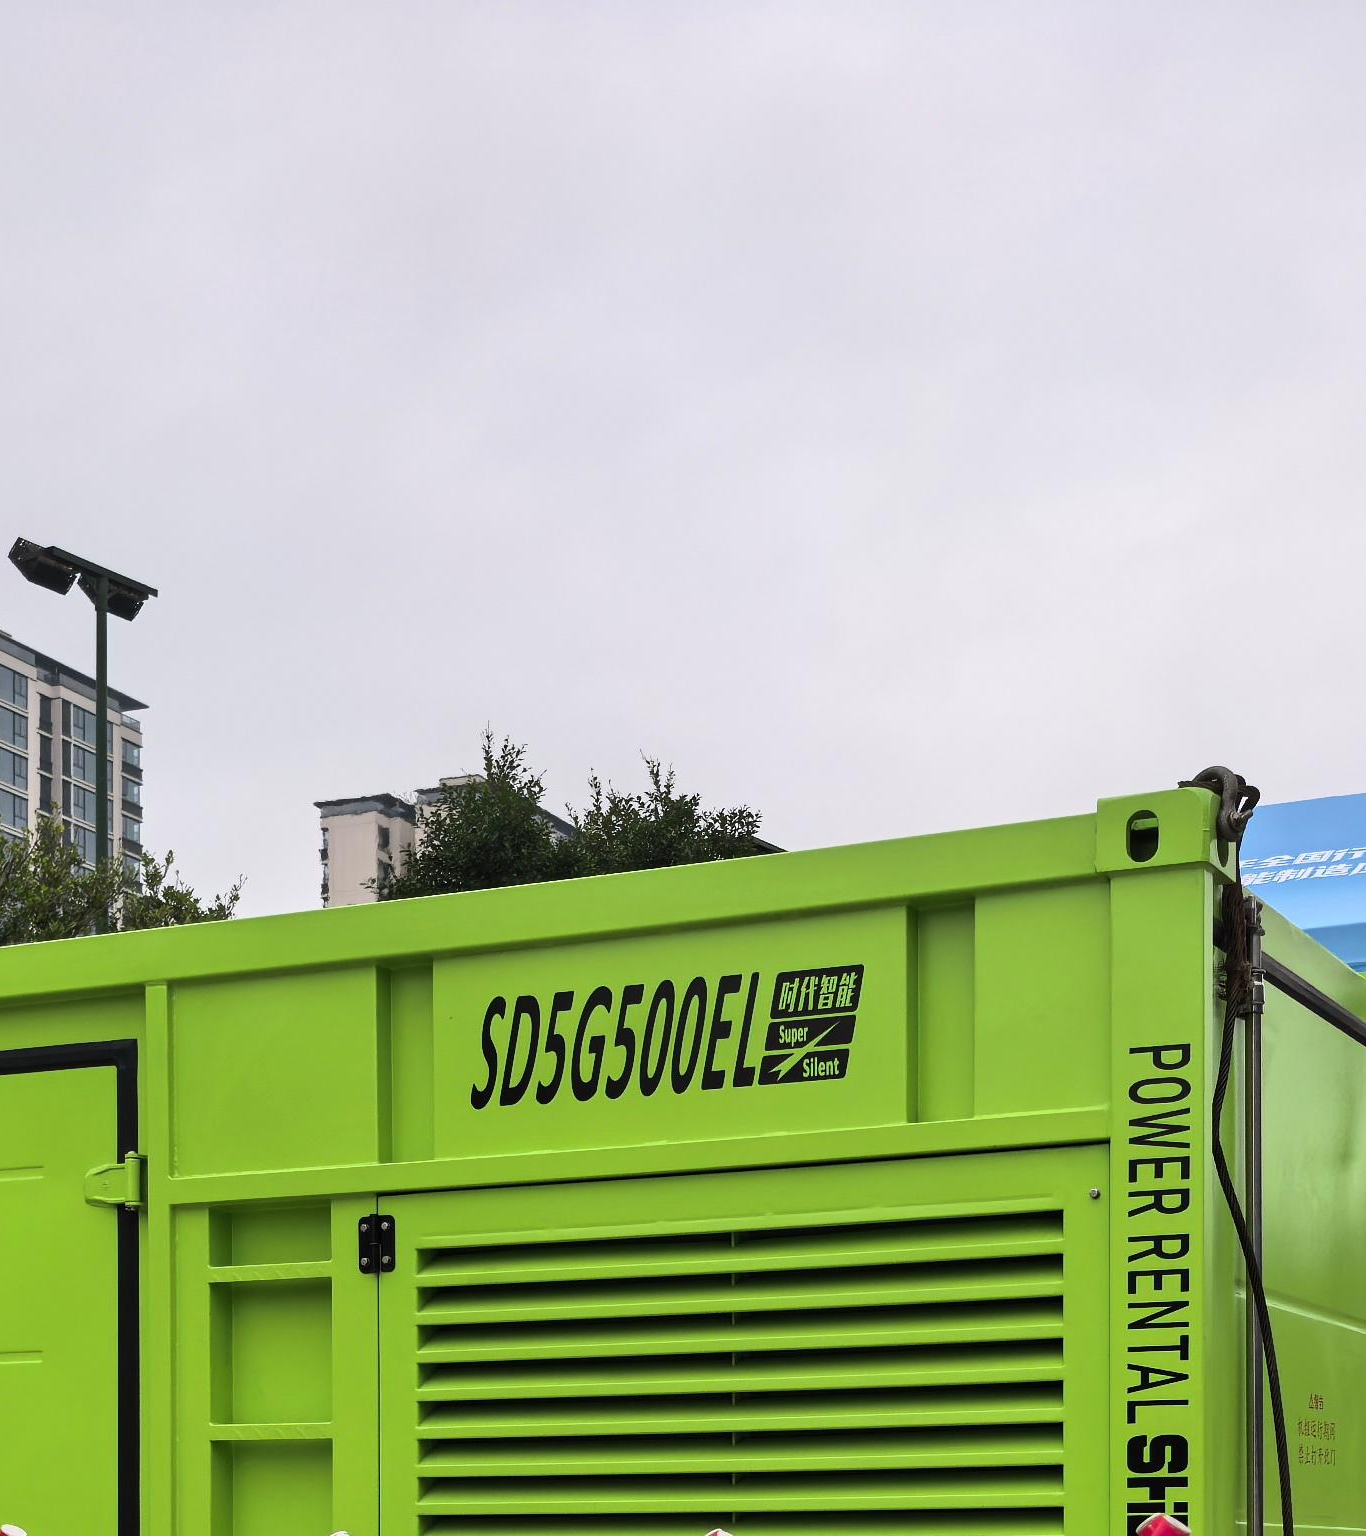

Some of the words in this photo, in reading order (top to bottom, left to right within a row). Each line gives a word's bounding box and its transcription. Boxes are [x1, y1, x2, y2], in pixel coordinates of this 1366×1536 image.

[778, 971, 860, 1013] 时代智能
[778, 1025, 809, 1047] Super
[470, 971, 760, 1110] SD5G500EL
[802, 1056, 840, 1078] Silent
[1128, 1043, 1191, 1218] POWER
[1126, 1232, 1190, 1424] RENTAL
